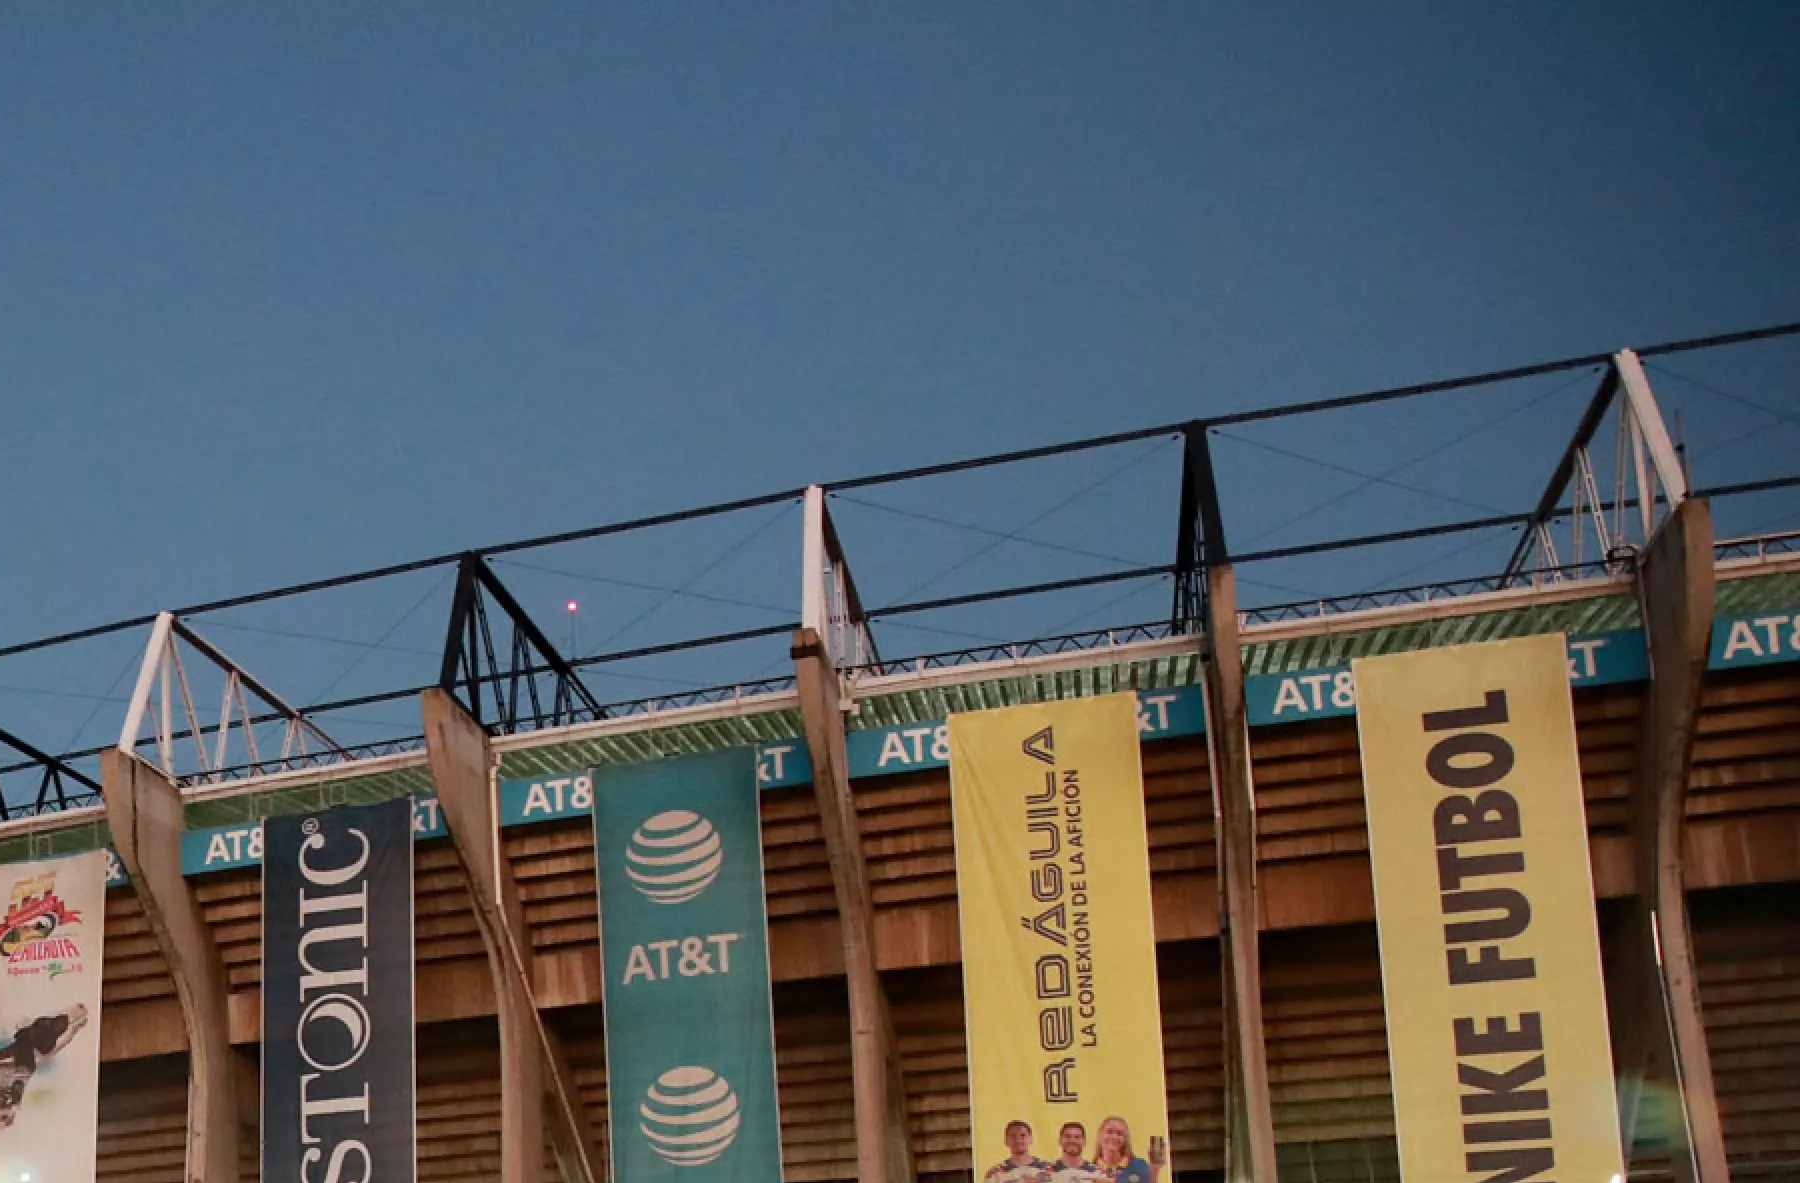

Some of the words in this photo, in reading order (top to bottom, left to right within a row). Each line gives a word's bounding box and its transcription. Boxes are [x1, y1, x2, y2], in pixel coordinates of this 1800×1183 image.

[1723, 614, 1800, 660] AT
[1272, 671, 1355, 715] AT&
[879, 726, 950, 767] AT&
[523, 775, 593, 816] AT&
[1059, 769, 1084, 848] AFICIÓN
[1421, 689, 1537, 986] FUTBOL
[1068, 851, 1087, 875] LA
[1070, 880, 1089, 907] DE
[622, 933, 742, 986] AT&T
[1069, 911, 1096, 1019] CONEXIÓN
[1081, 1023, 1097, 1047] LA
